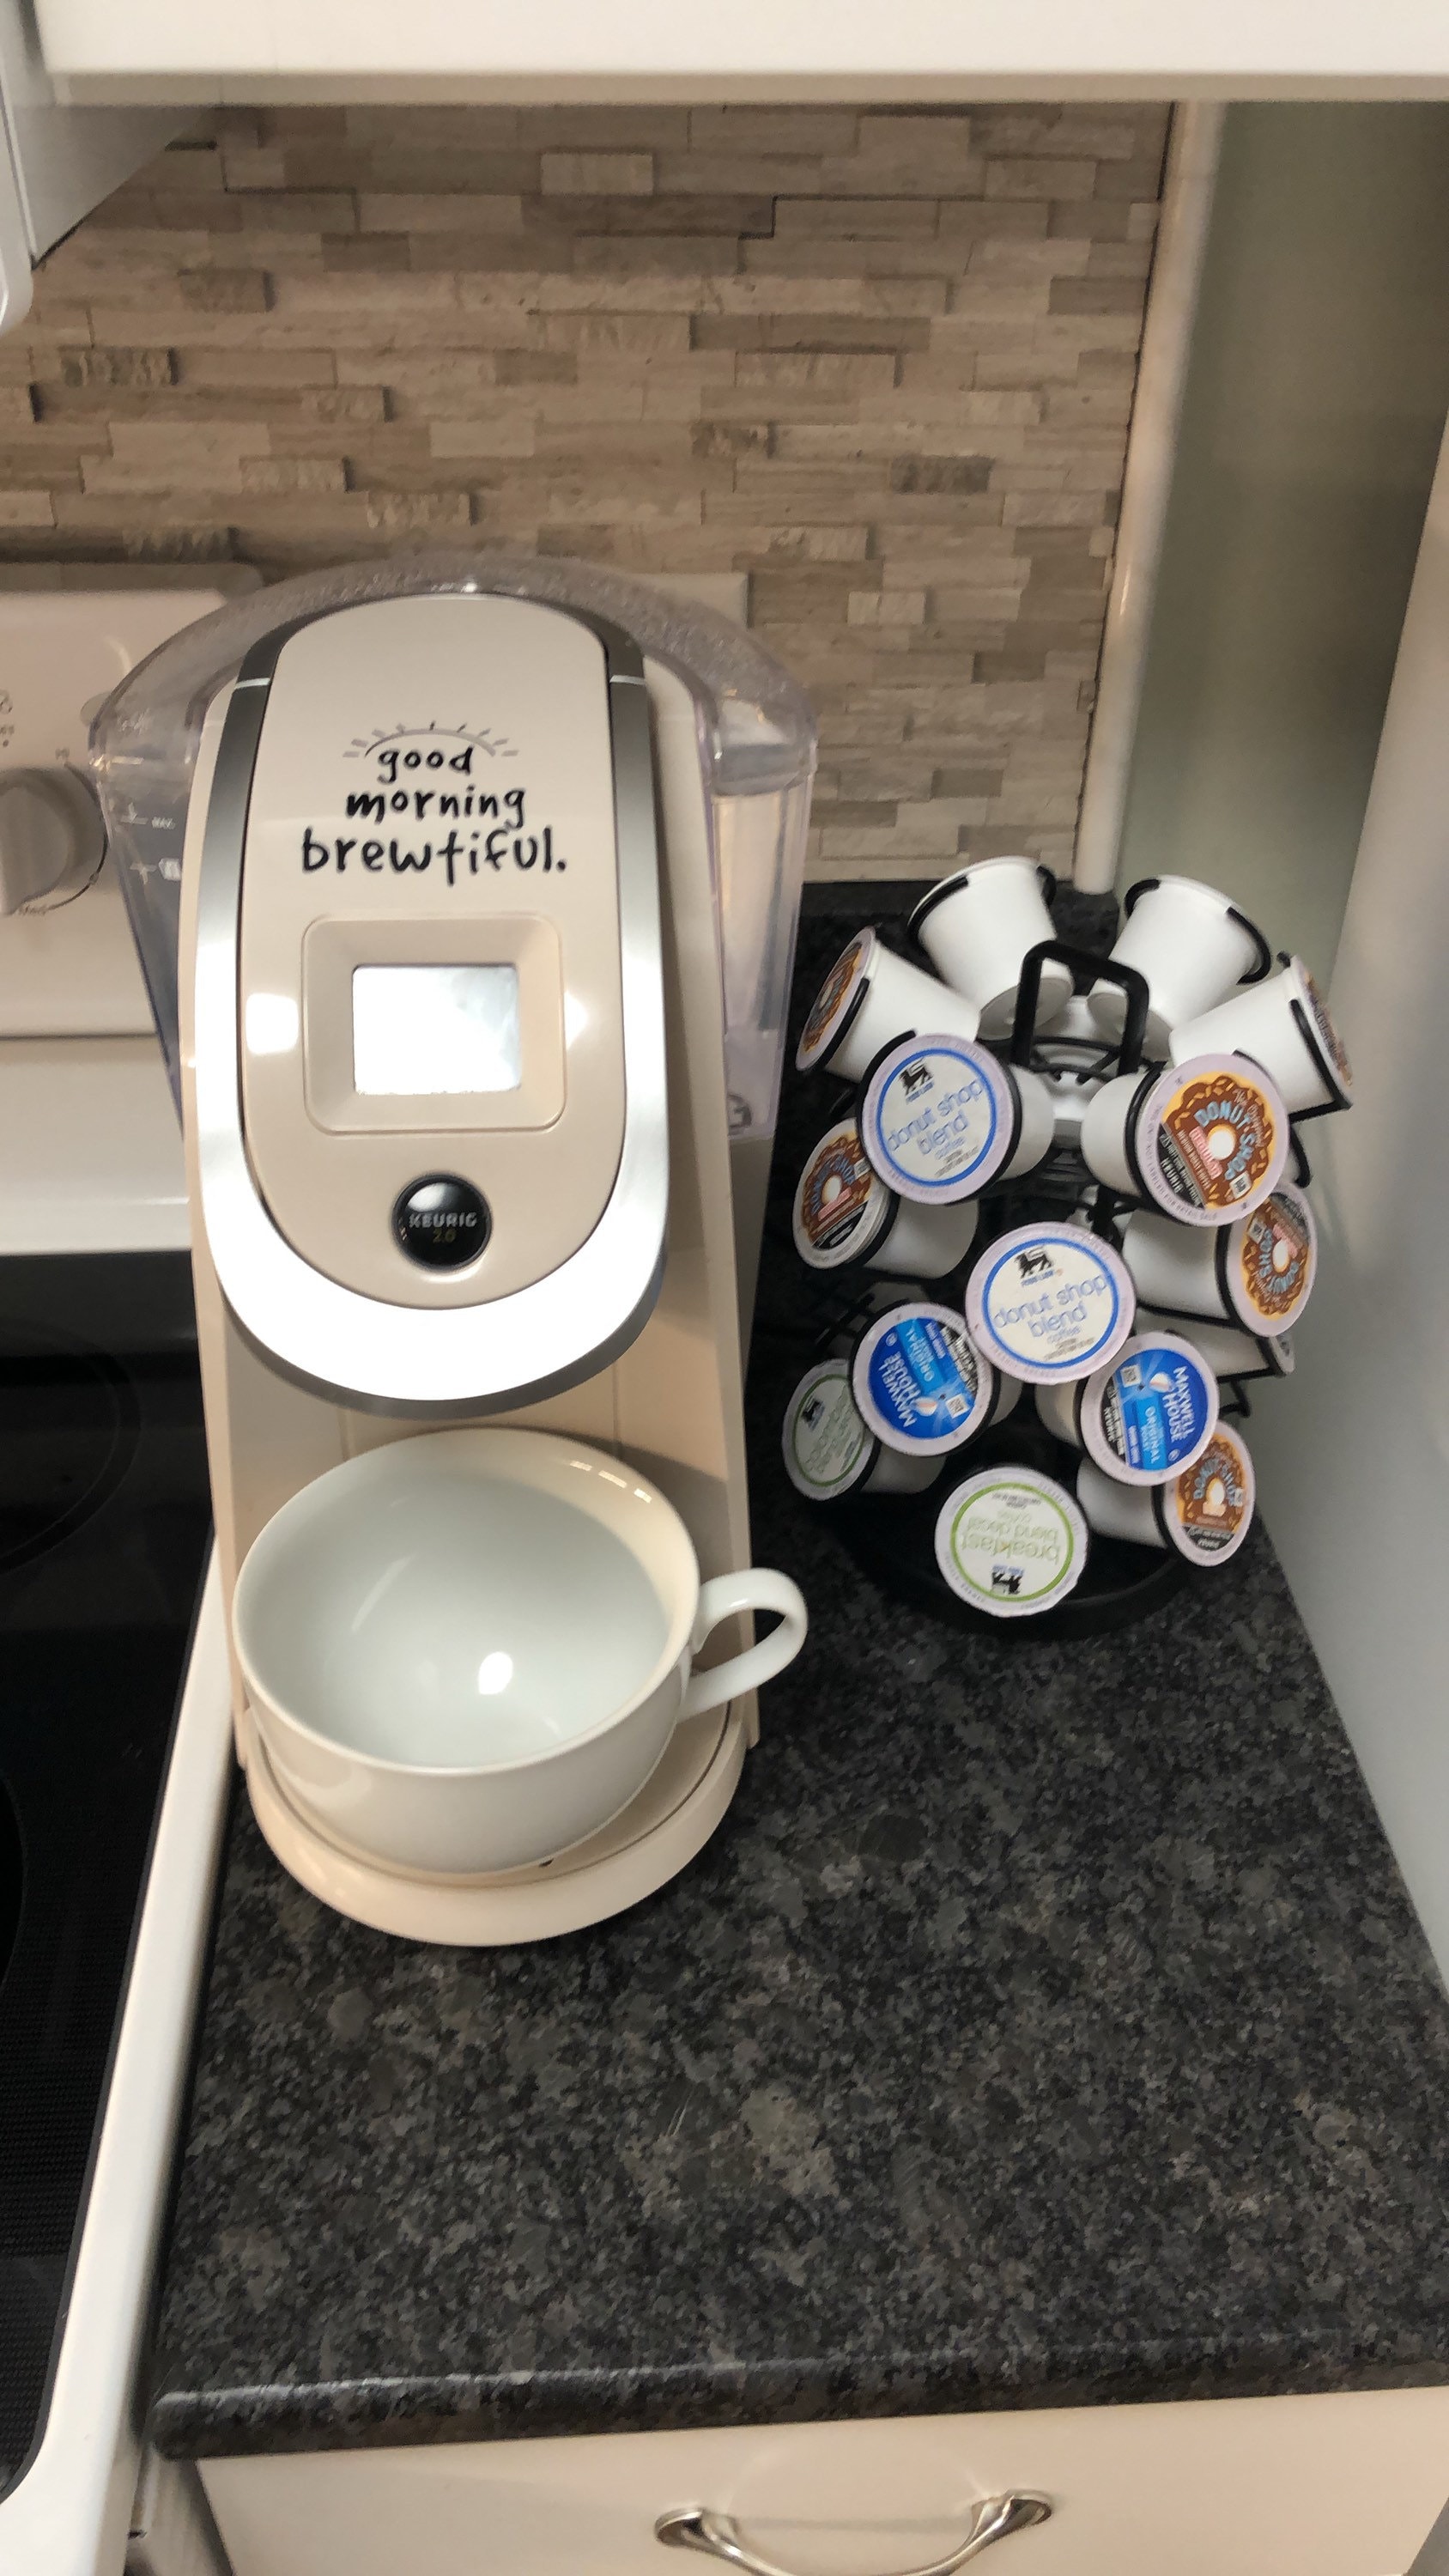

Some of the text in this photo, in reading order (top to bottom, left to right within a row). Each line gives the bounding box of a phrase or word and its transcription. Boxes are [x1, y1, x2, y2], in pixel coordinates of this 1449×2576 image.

[377, 745, 475, 784] good
[345, 783, 526, 829] morning
[301, 825, 567, 887] brewtiful.
[886, 1078, 984, 1152] donut shop
[917, 1110, 969, 1155] blend
[1193, 1100, 1256, 1181] DONUT SHOP
[1161, 1157, 1184, 1194] KEURIG
[409, 1212, 478, 1229] KEURIG
[992, 1274, 1108, 1329] donut shop
[1028, 1301, 1088, 1337] blend
[890, 1351, 922, 1400] HOUSE
[905, 1327, 935, 1382] ORIGINAL
[878, 1363, 918, 1428] MAXWELL
[1162, 1392, 1187, 1443] HOUSE
[1173, 1365, 1196, 1437] MAXWELL
[1144, 1406, 1164, 1464] ORIGINAL
[961, 1534, 1060, 1565] breakfast
